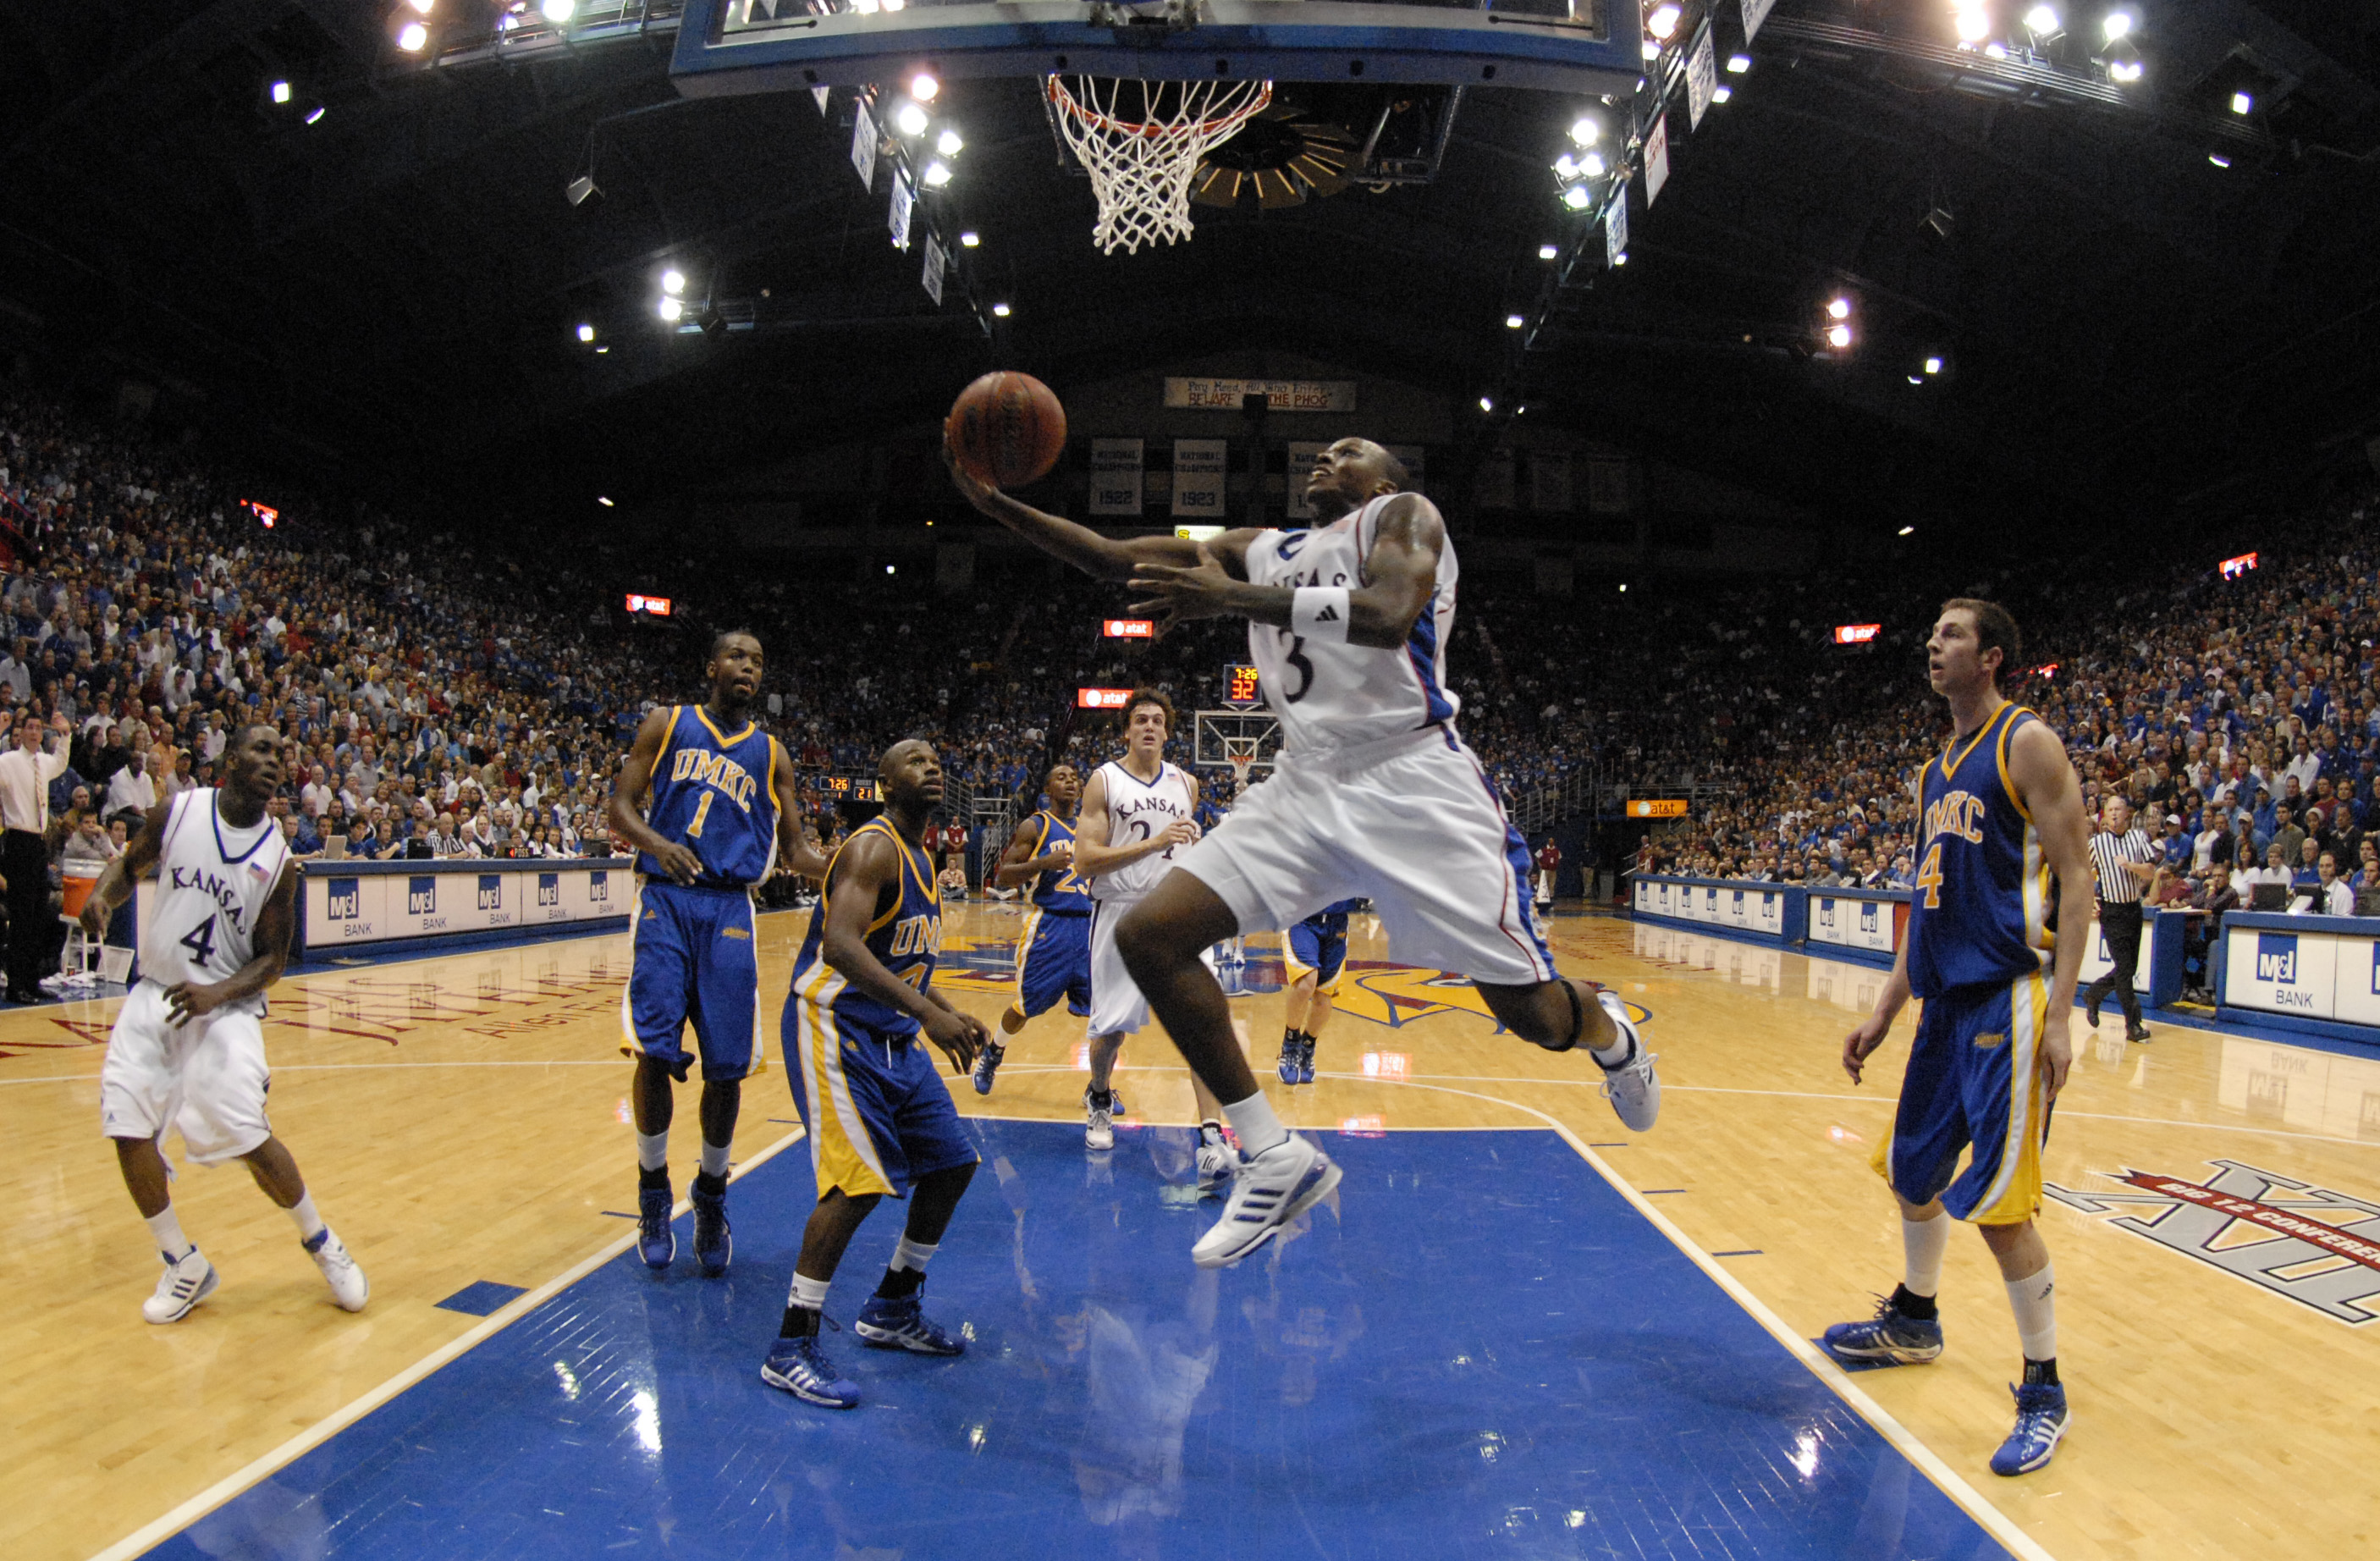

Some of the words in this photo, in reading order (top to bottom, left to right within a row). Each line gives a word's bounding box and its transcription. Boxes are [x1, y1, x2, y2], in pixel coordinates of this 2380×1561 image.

[1188, 393, 1235, 406] BEWARE
[1236, 668, 1258, 680] 7:26
[1232, 680, 1253, 699] 32
[671, 747, 757, 814] UMKC
[686, 790, 714, 838] 1
[1651, 803, 1674, 814] at&t
[1916, 842, 1943, 909] 4
[422, 917, 446, 930] BANK
[490, 913, 510, 924] BANK
[344, 923, 372, 937] BANK
[179, 913, 217, 968] 4
[2276, 989, 2313, 1008] BANK
[2156, 1183, 2213, 1199] BIG
[2212, 1198, 2256, 1212] 12
[2252, 1211, 2380, 1264] CONFEREN
